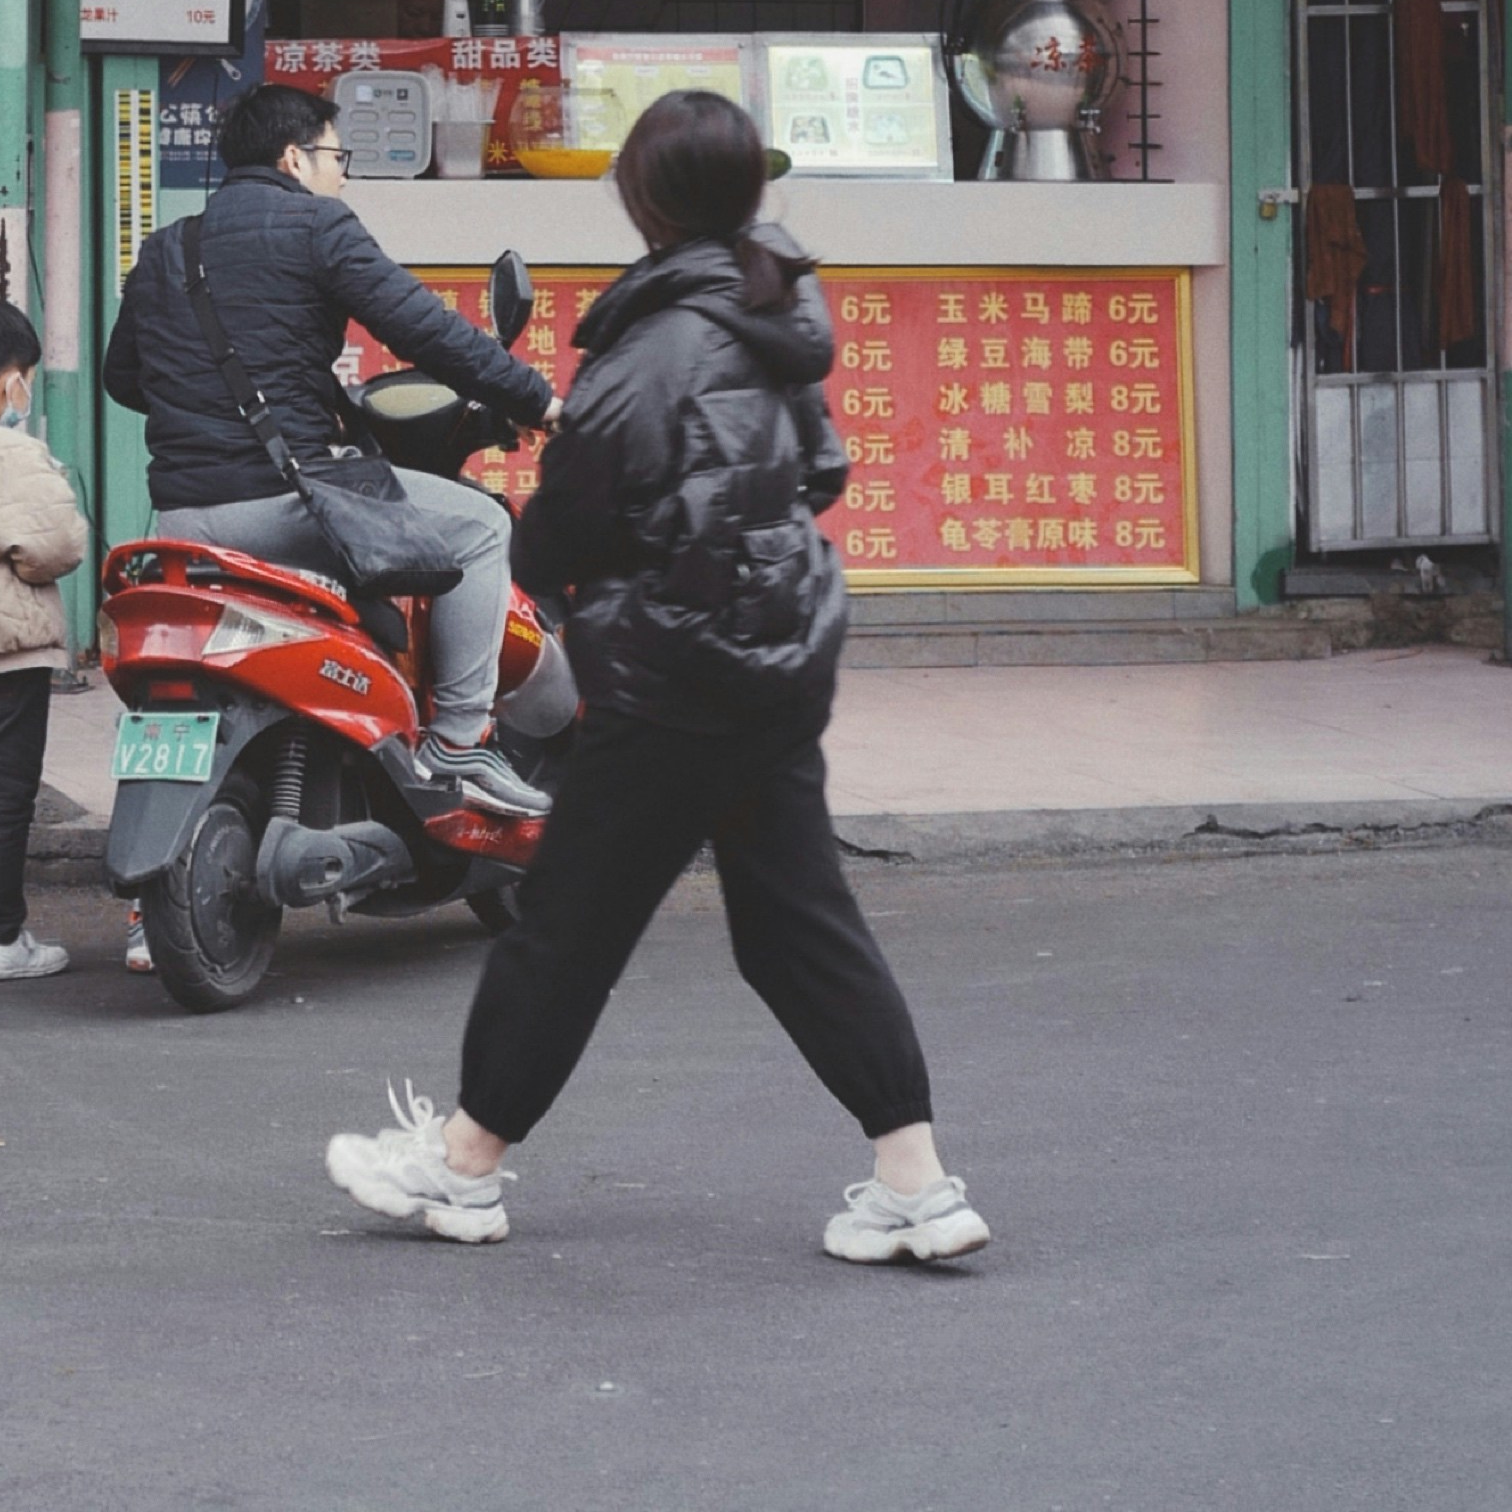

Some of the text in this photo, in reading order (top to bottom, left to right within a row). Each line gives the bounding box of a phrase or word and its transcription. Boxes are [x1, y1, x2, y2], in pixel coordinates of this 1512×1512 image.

[187, 10, 215, 25] 10元
[274, 37, 559, 73] 凉茶类 甜品类
[841, 294, 892, 325] 6元
[937, 292, 1159, 325] 玉米马蹄 6元
[841, 340, 893, 372] 6元
[938, 337, 1160, 370] 绿豆海带 6元
[842, 388, 894, 418] 6元
[939, 382, 1161, 415] 冰糖雪梨 8元
[844, 435, 895, 465] 6元
[938, 427, 1163, 461] 清补凉 8元
[845, 481, 896, 512] 6元
[941, 473, 1164, 505] 银耳红枣 8元
[846, 528, 897, 558] 6元
[940, 518, 1165, 551] 龟苓膏原味 8元
[120, 743, 209, 775] V2817
